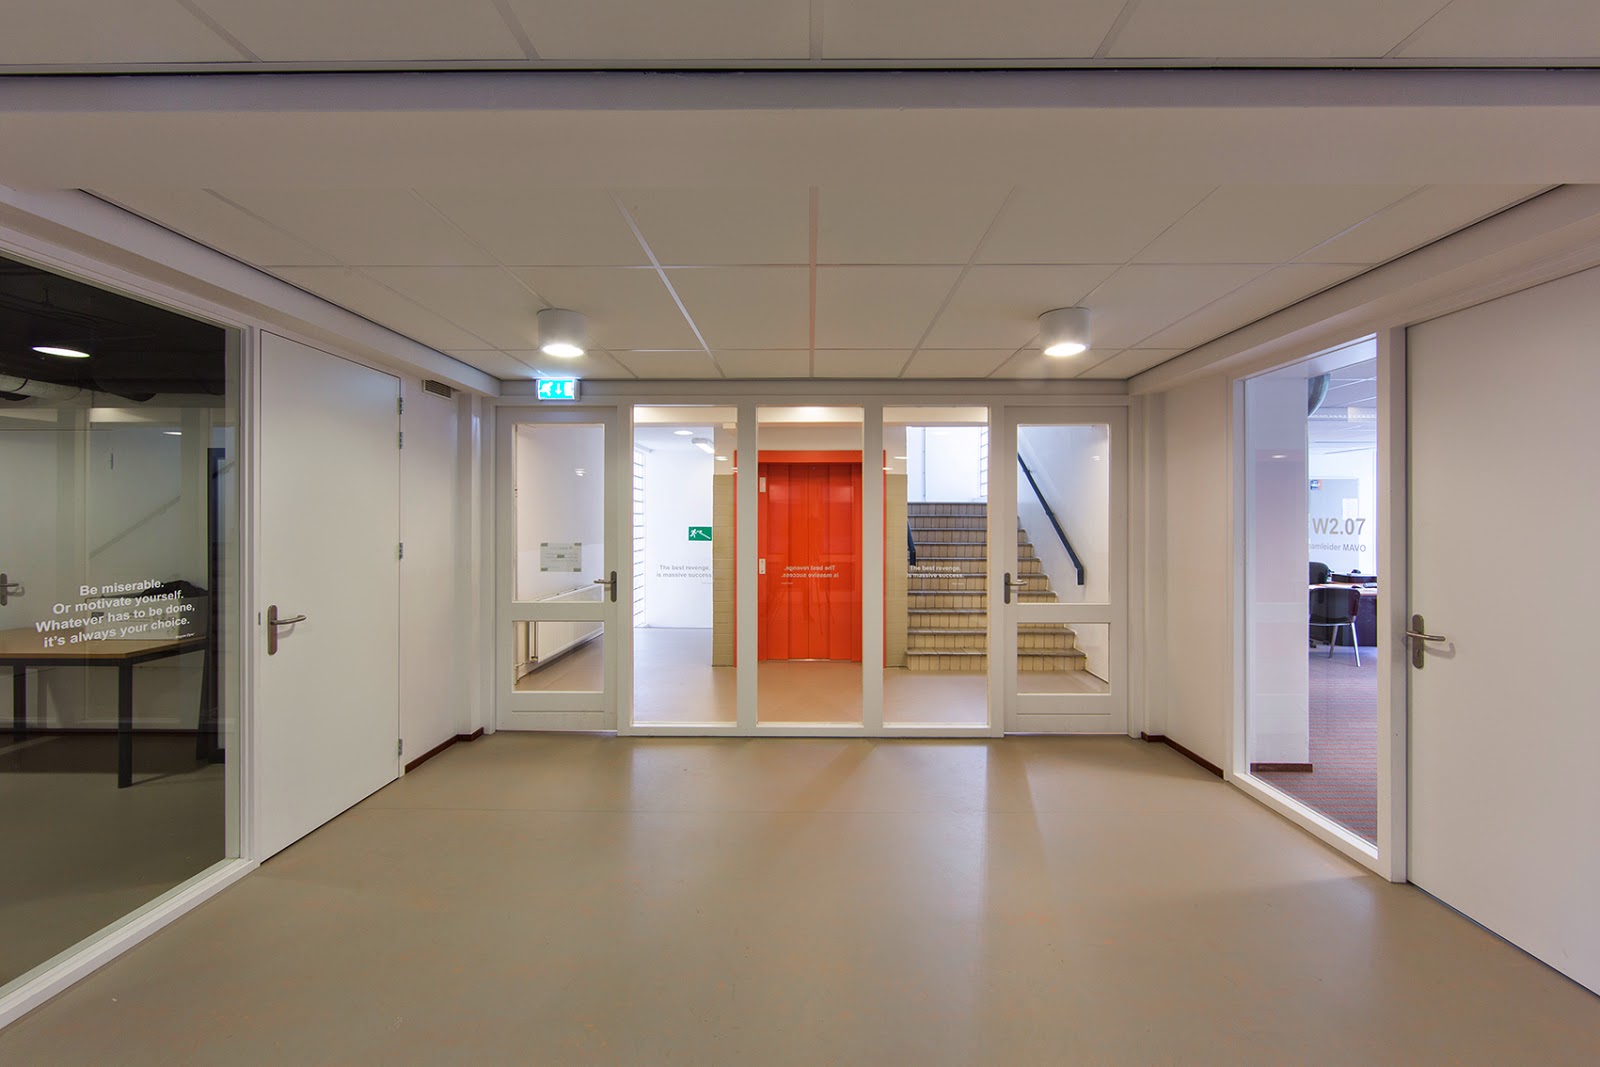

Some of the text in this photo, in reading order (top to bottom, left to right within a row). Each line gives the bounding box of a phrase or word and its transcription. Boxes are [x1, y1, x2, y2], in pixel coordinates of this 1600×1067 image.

[1312, 518, 1366, 535] W2.07
[1342, 544, 1367, 552] MAVO
[80, 580, 164, 596] Be miserable.
[52, 590, 184, 614] Or motivate yourself.
[36, 616, 104, 633] Whatever
[108, 612, 130, 622] has
[133, 609, 146, 618] to
[148, 607, 162, 616] be
[166, 603, 196, 614] done,
[44, 636, 66, 648] it's
[70, 628, 117, 641] always
[120, 624, 149, 638] your
[150, 618, 190, 630] choice.
